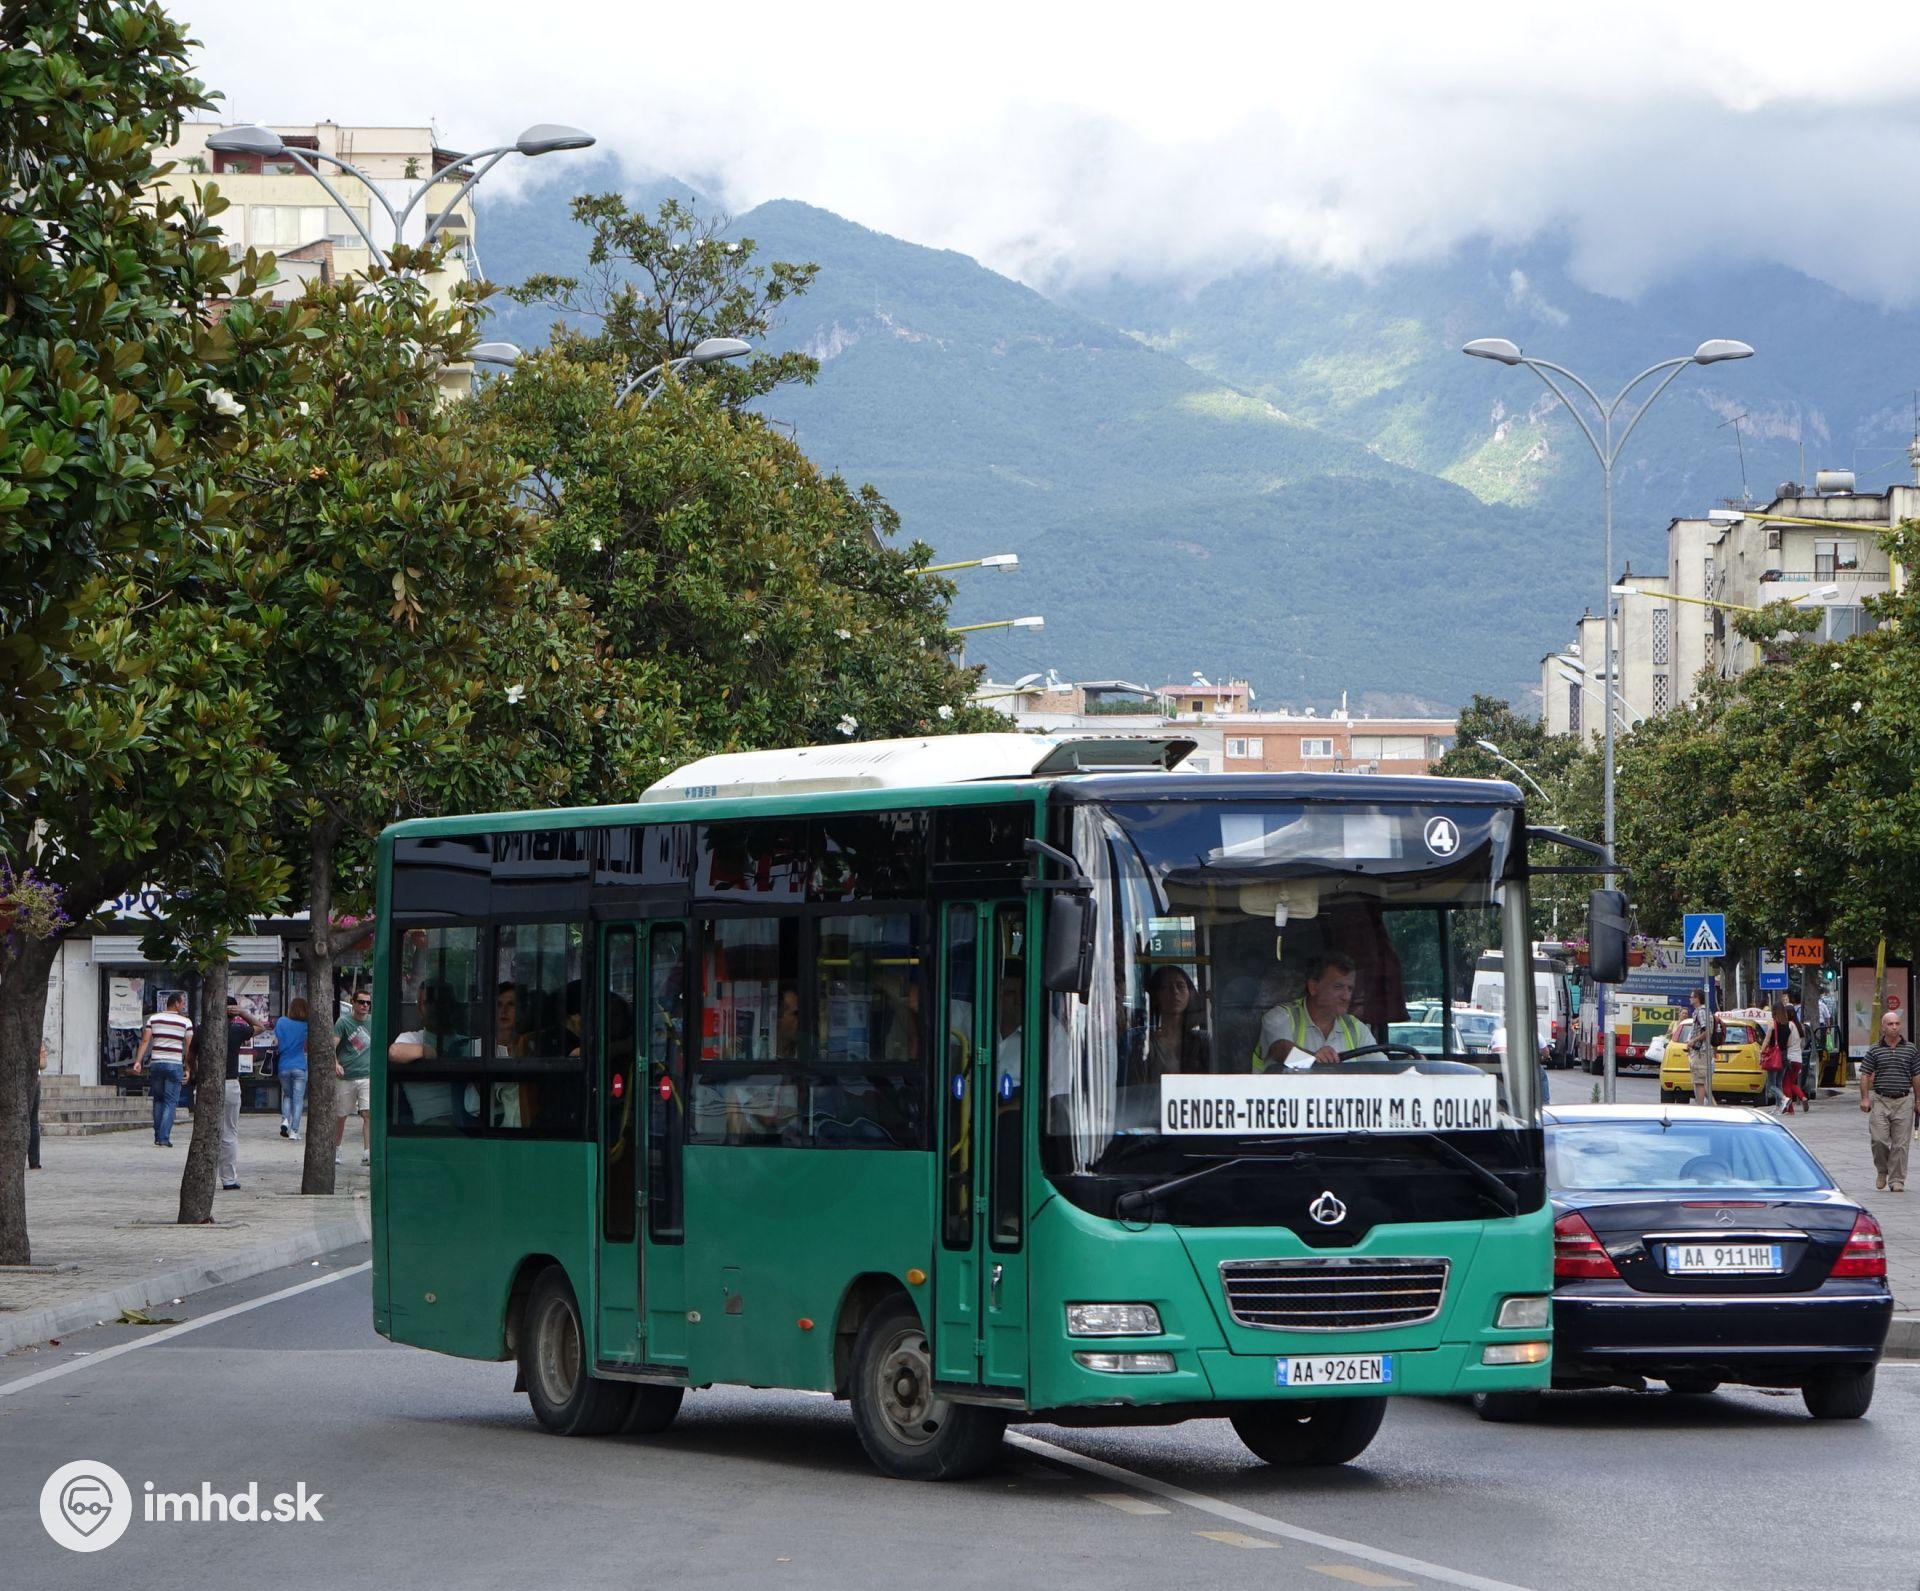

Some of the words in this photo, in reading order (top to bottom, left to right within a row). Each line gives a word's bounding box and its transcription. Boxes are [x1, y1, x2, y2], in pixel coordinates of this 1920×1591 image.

[1430, 821, 1453, 851] 4
[1789, 944, 1821, 957] TAXI
[1167, 1098, 1299, 1130] QENDER-TREGU
[1306, 1098, 1382, 1128] ELEKTRIK
[1433, 1097, 1492, 1128] COLLAK
[1684, 1248, 1705, 1266] AA
[1293, 1361, 1314, 1382] AA
